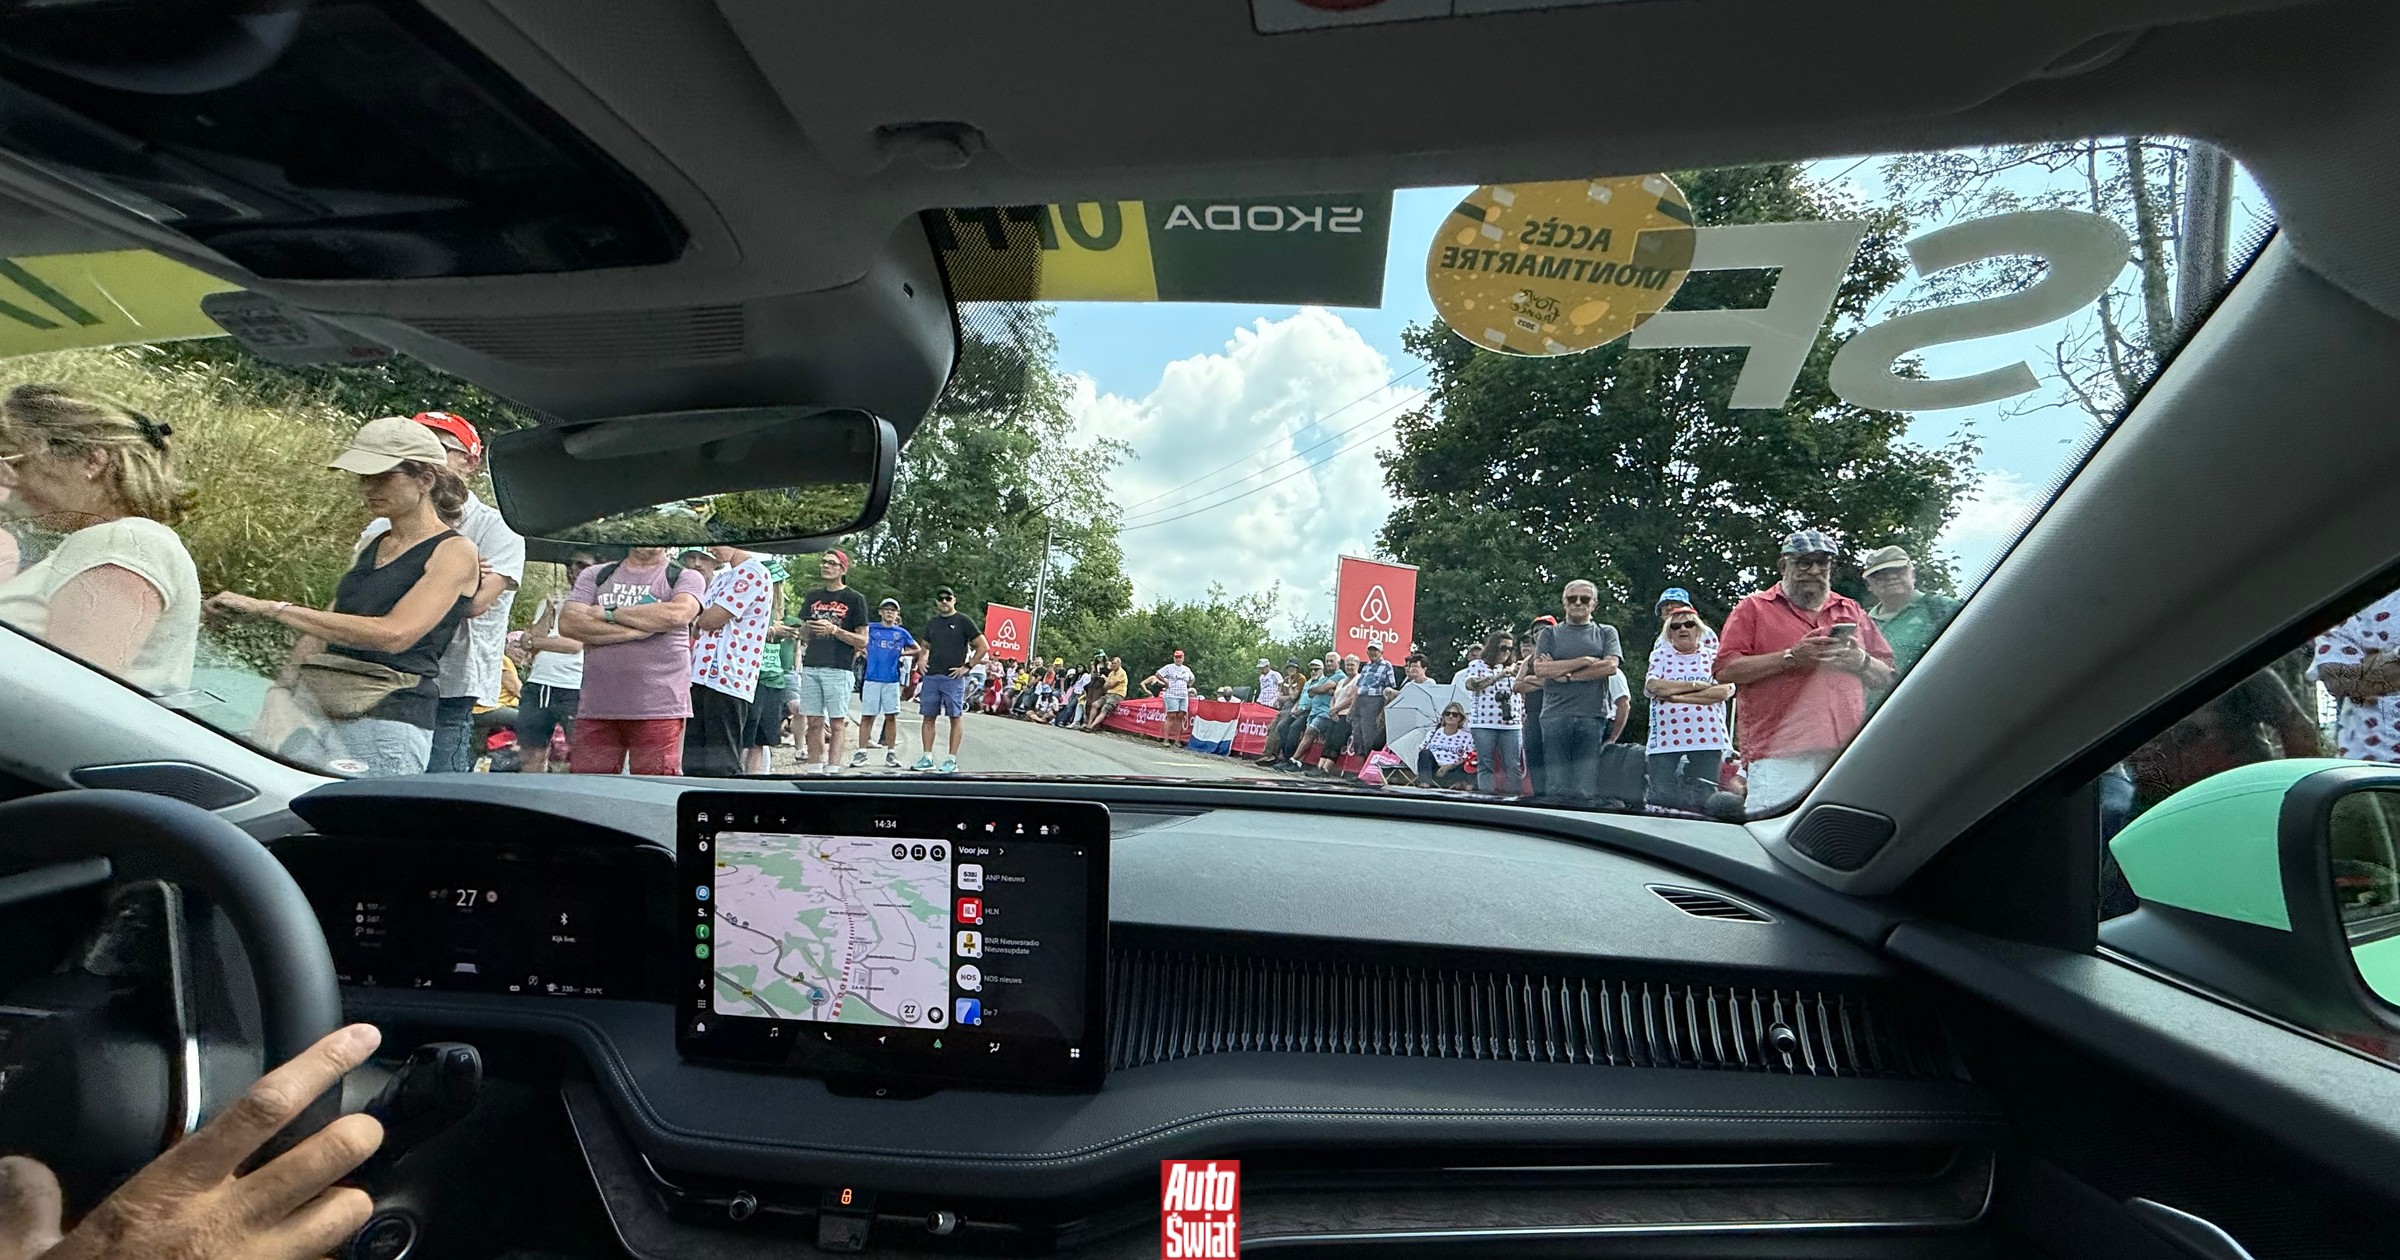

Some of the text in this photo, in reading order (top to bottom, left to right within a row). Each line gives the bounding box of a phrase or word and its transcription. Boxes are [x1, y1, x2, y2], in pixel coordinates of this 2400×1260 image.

[613, 583, 651, 596] PLAYA
[1349, 623, 1400, 644] airbnb
[991, 639, 1021, 651] airbnb
[1239, 718, 1268, 737] airbnb
[874, 820, 897, 829] 14:34
[958, 846, 989, 856] Voor jou
[1001, 875, 1026, 883] Nieuws
[456, 889, 478, 907] 27
[984, 908, 1000, 916] HLN
[1000, 938, 1040, 947] Nieuwsradio
[984, 946, 1030, 955] Nieuwsupdate
[983, 975, 1023, 984] NOS nieuws
[904, 1004, 916, 1014] 27
[460, 1053, 469, 1063] P
